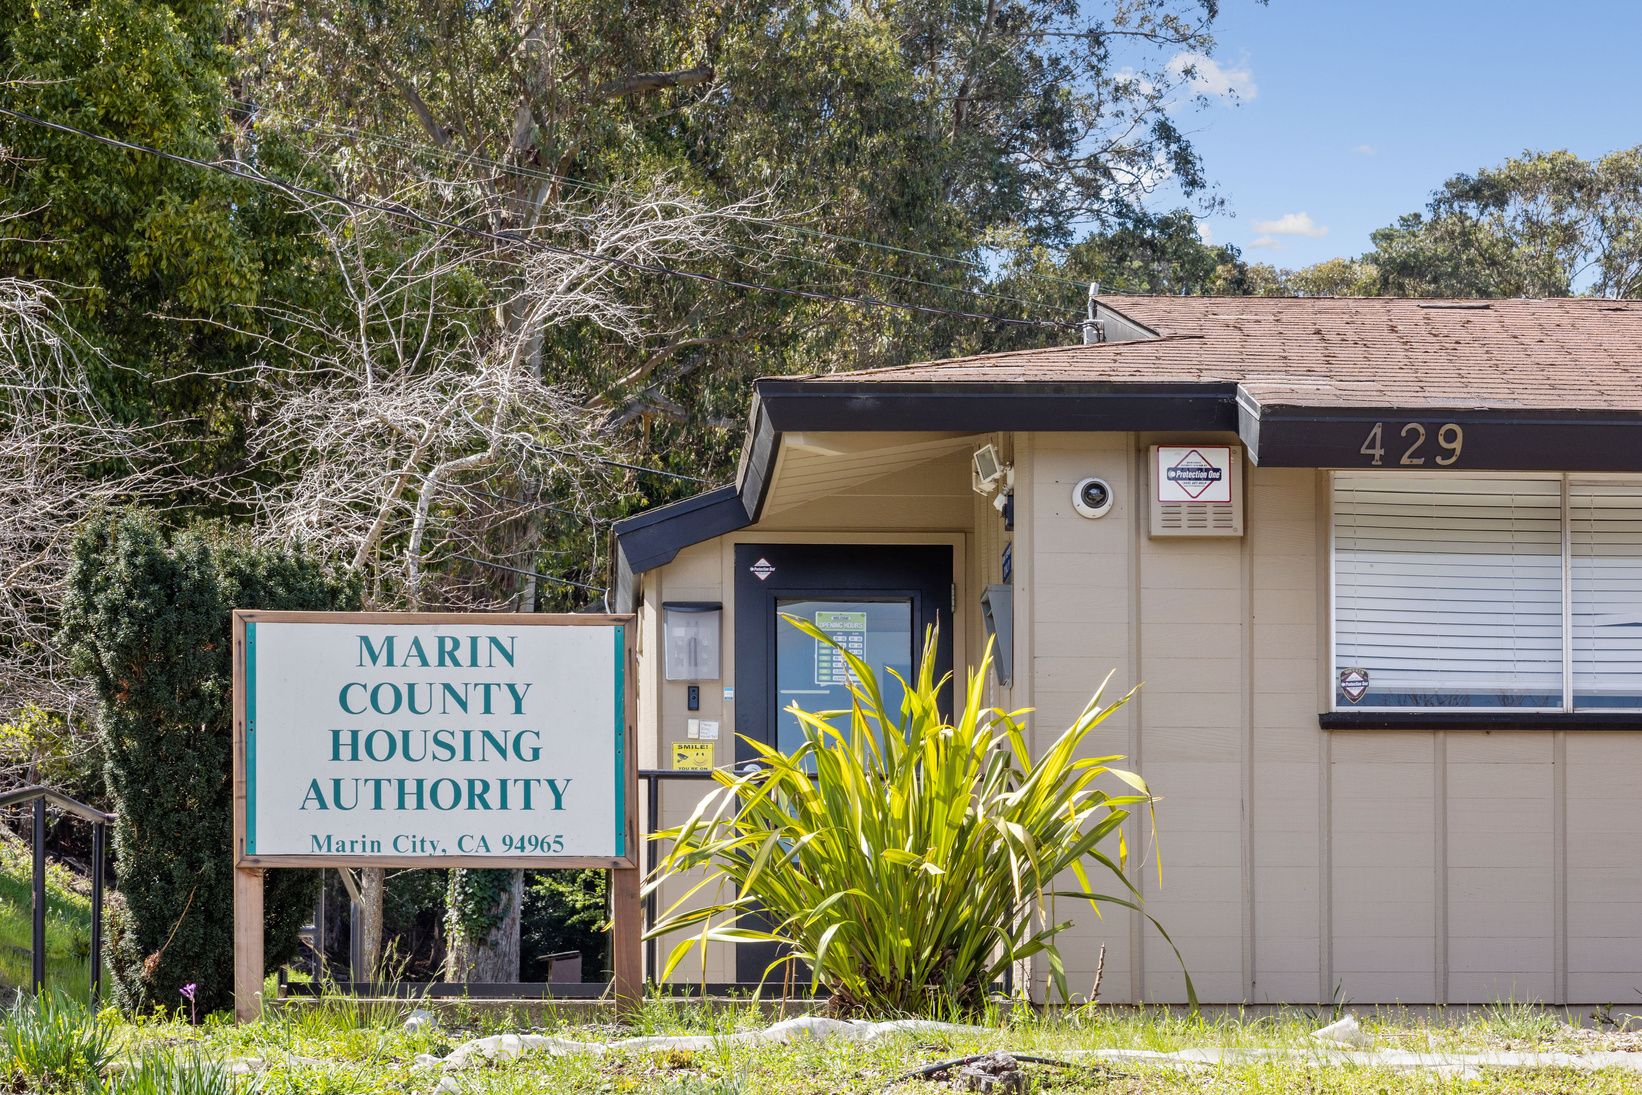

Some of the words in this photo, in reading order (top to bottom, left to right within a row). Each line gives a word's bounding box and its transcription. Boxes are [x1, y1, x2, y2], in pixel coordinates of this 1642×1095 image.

[1360, 422, 1464, 466] 429
[1176, 470, 1207, 479] Protection
[1208, 470, 1220, 479] One
[356, 635, 517, 668] MARIN
[338, 682, 533, 715] COUNTY
[328, 729, 543, 763] HOUSING
[299, 778, 573, 811] AUTHORITY
[310, 834, 382, 854] Marin
[393, 834, 448, 857] City,
[457, 834, 492, 854] CA
[501, 834, 565, 854] 94965
